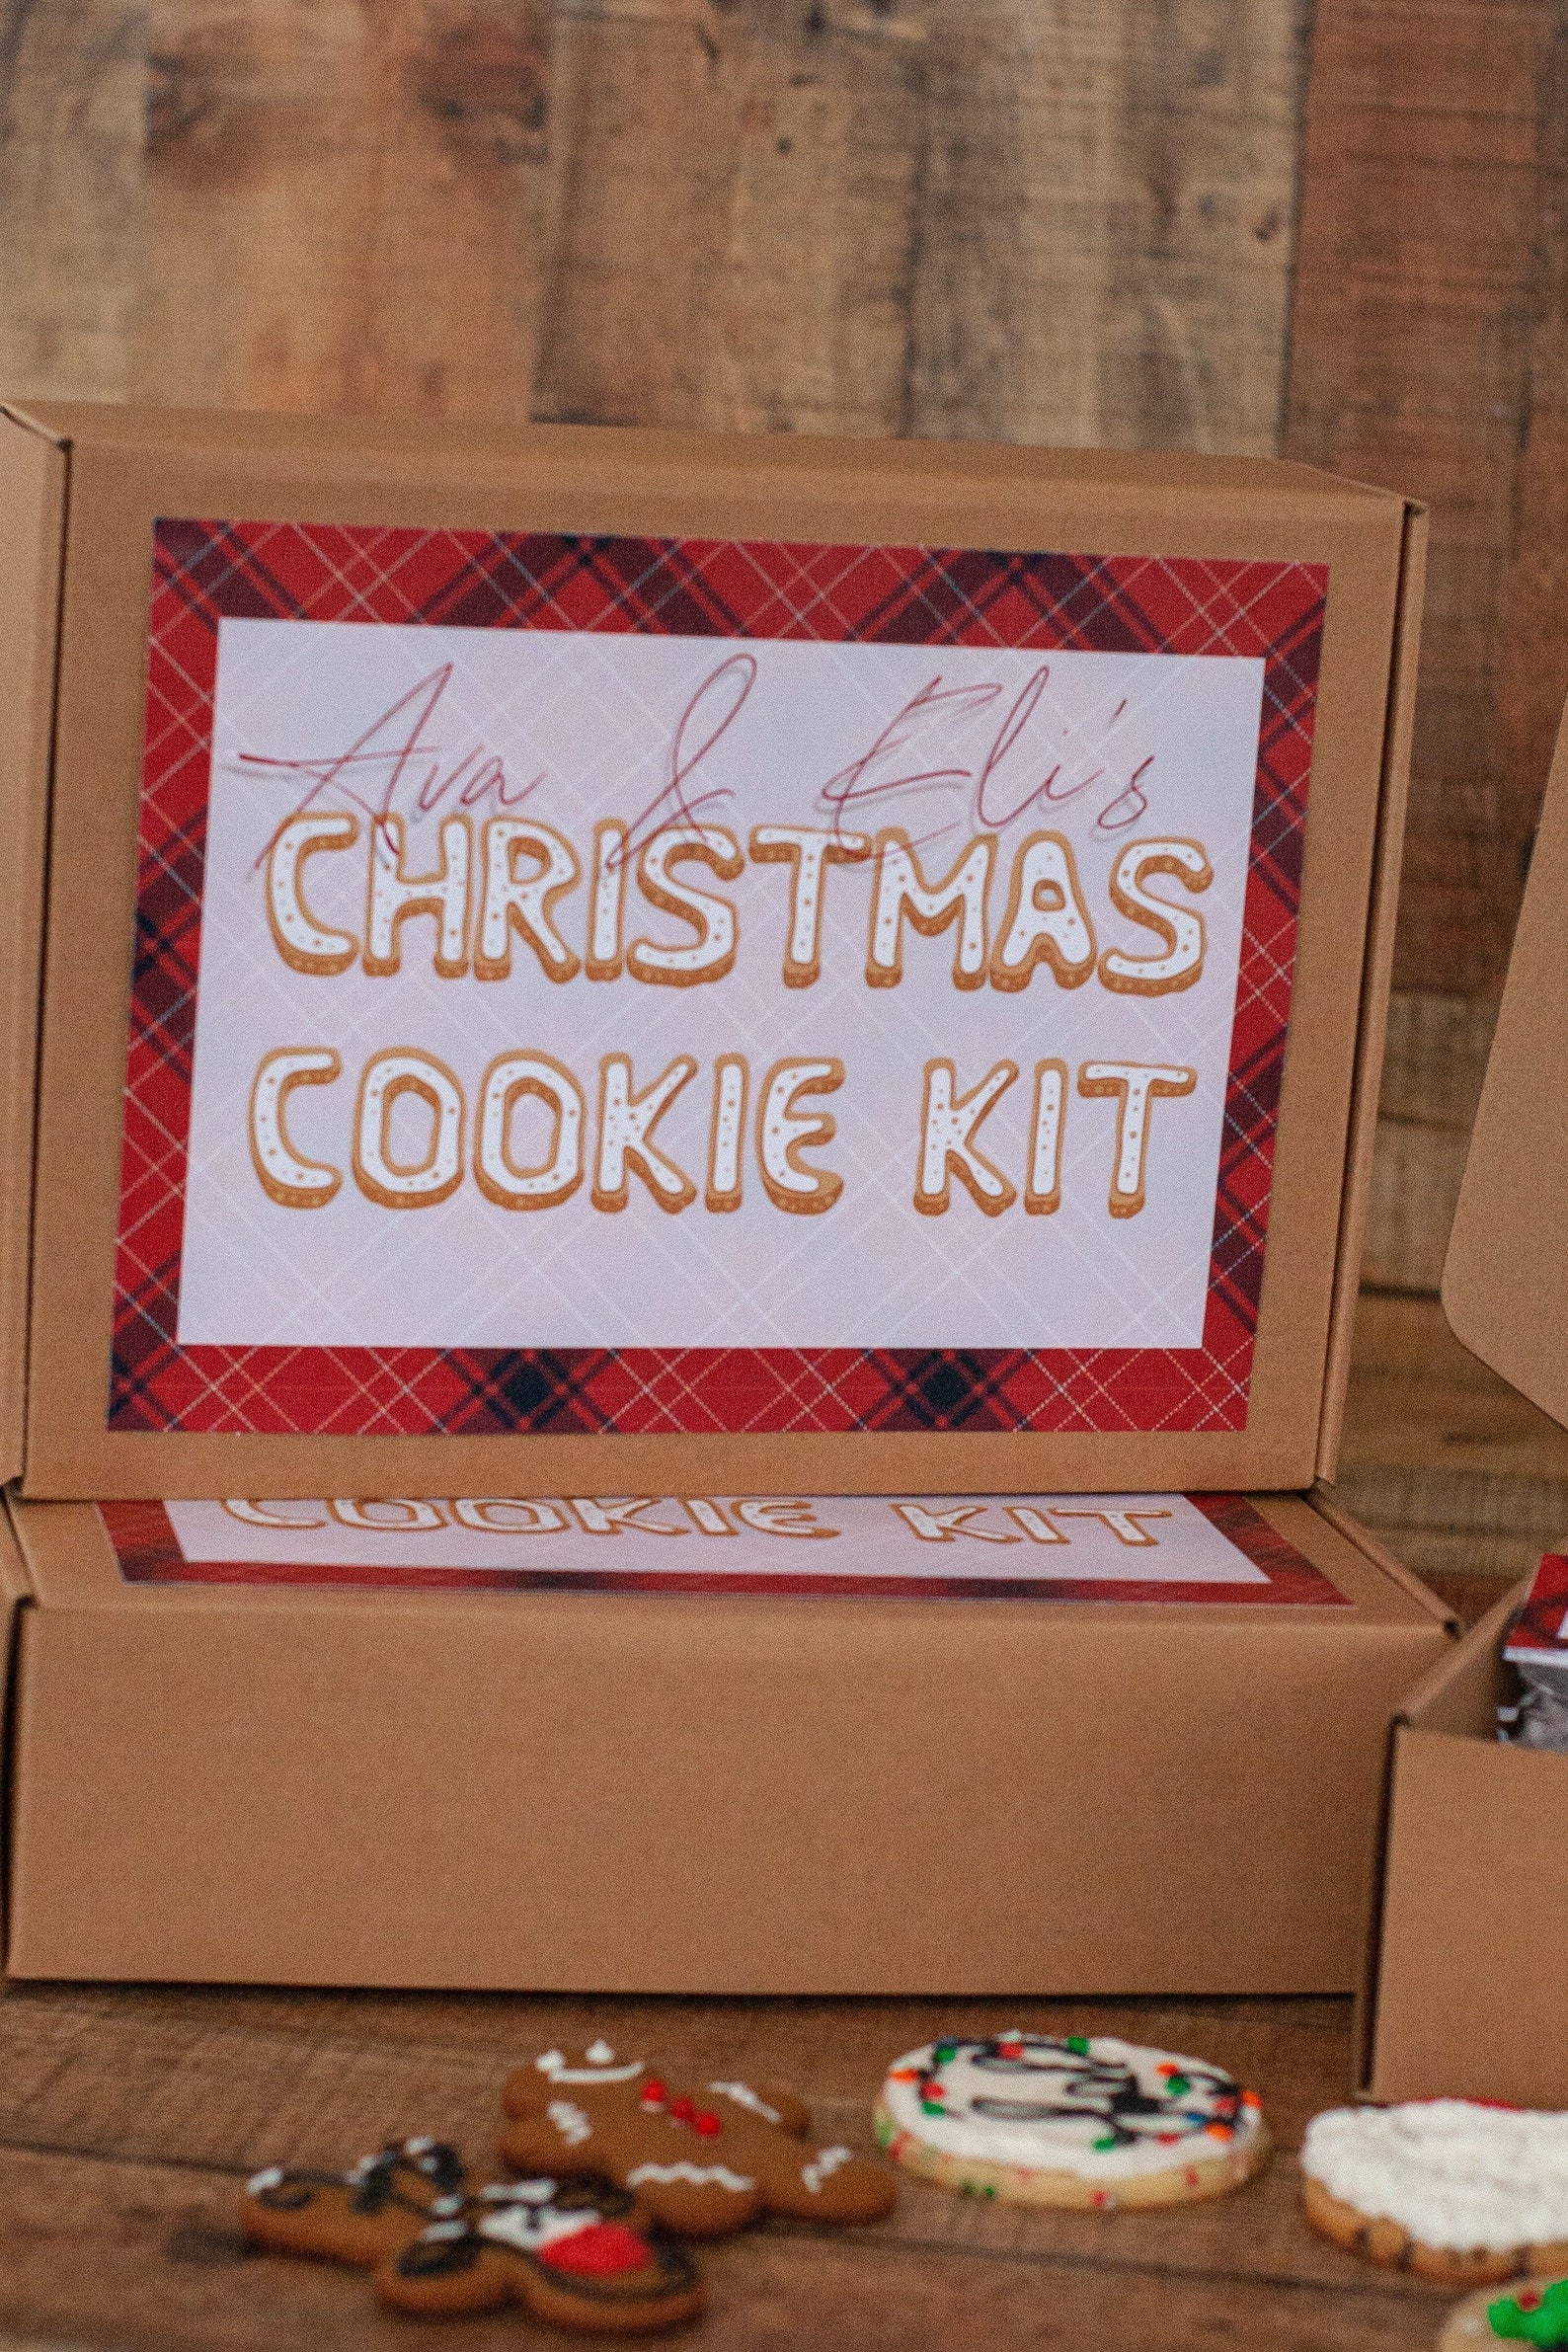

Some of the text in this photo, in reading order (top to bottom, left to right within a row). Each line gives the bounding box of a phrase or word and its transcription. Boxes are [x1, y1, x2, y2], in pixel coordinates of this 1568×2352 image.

[239, 653, 1154, 870] Ava & Eli's
[265, 812, 1214, 997] CHRISTMAS
[249, 1046, 1197, 1218] COOKIE KIT
[890, 1503, 1173, 1547] KIT
